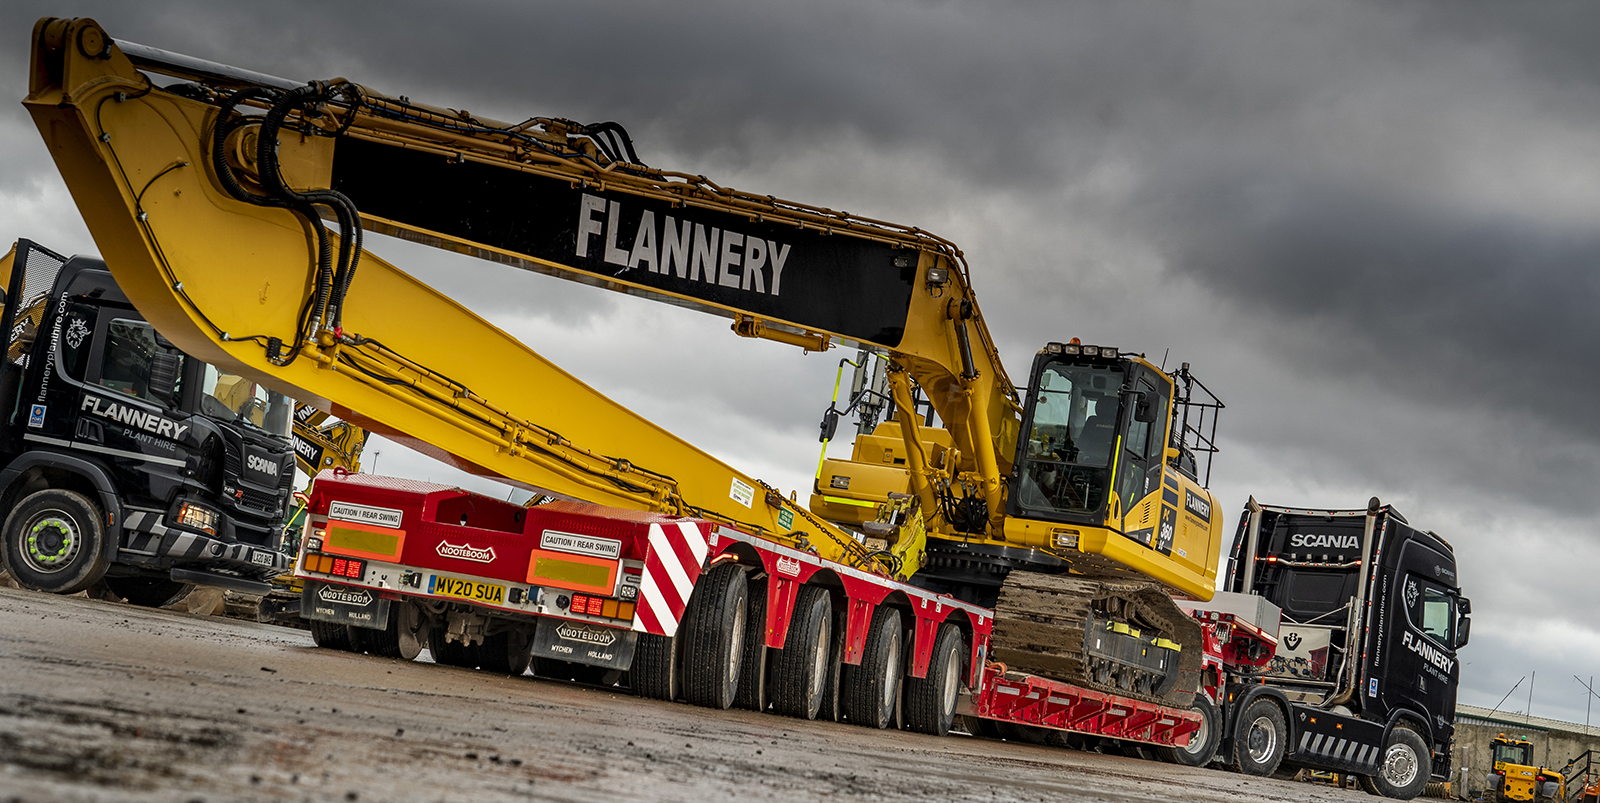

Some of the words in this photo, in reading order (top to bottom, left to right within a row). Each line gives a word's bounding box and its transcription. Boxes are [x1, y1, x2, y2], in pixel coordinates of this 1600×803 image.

[576, 193, 791, 296] FLANNERY
[38, 292, 68, 402] flanneryplanthire.com
[81, 394, 188, 440] FLANNERY
[123, 428, 154, 444] PLANT
[154, 438, 177, 451] HIRE
[291, 435, 318, 460] NERY
[247, 454, 277, 476] SCANIA
[333, 506, 358, 517] CAUTION
[362, 510, 379, 519] REAR
[379, 513, 398, 522] SWING
[1160, 522, 1173, 541] 360
[1290, 534, 1359, 549] SCANIA
[441, 546, 490, 560] NOOTEBOOM
[545, 536, 572, 546] CAUTION
[577, 540, 594, 549] REAR
[595, 543, 616, 553] SWING
[322, 590, 368, 603] NOOTEBOOM
[436, 577, 473, 597] MV20
[475, 584, 502, 602] SUA
[348, 611, 371, 620] HOLLAND
[1374, 574, 1388, 667] flanneryplanthire.com
[560, 627, 611, 643] NOOTEBOOM
[587, 650, 613, 660] HOLLAND
[1402, 631, 1454, 675] FLANNERY
[1423, 662, 1438, 677] PLANT
[1438, 672, 1449, 685] HIRE
